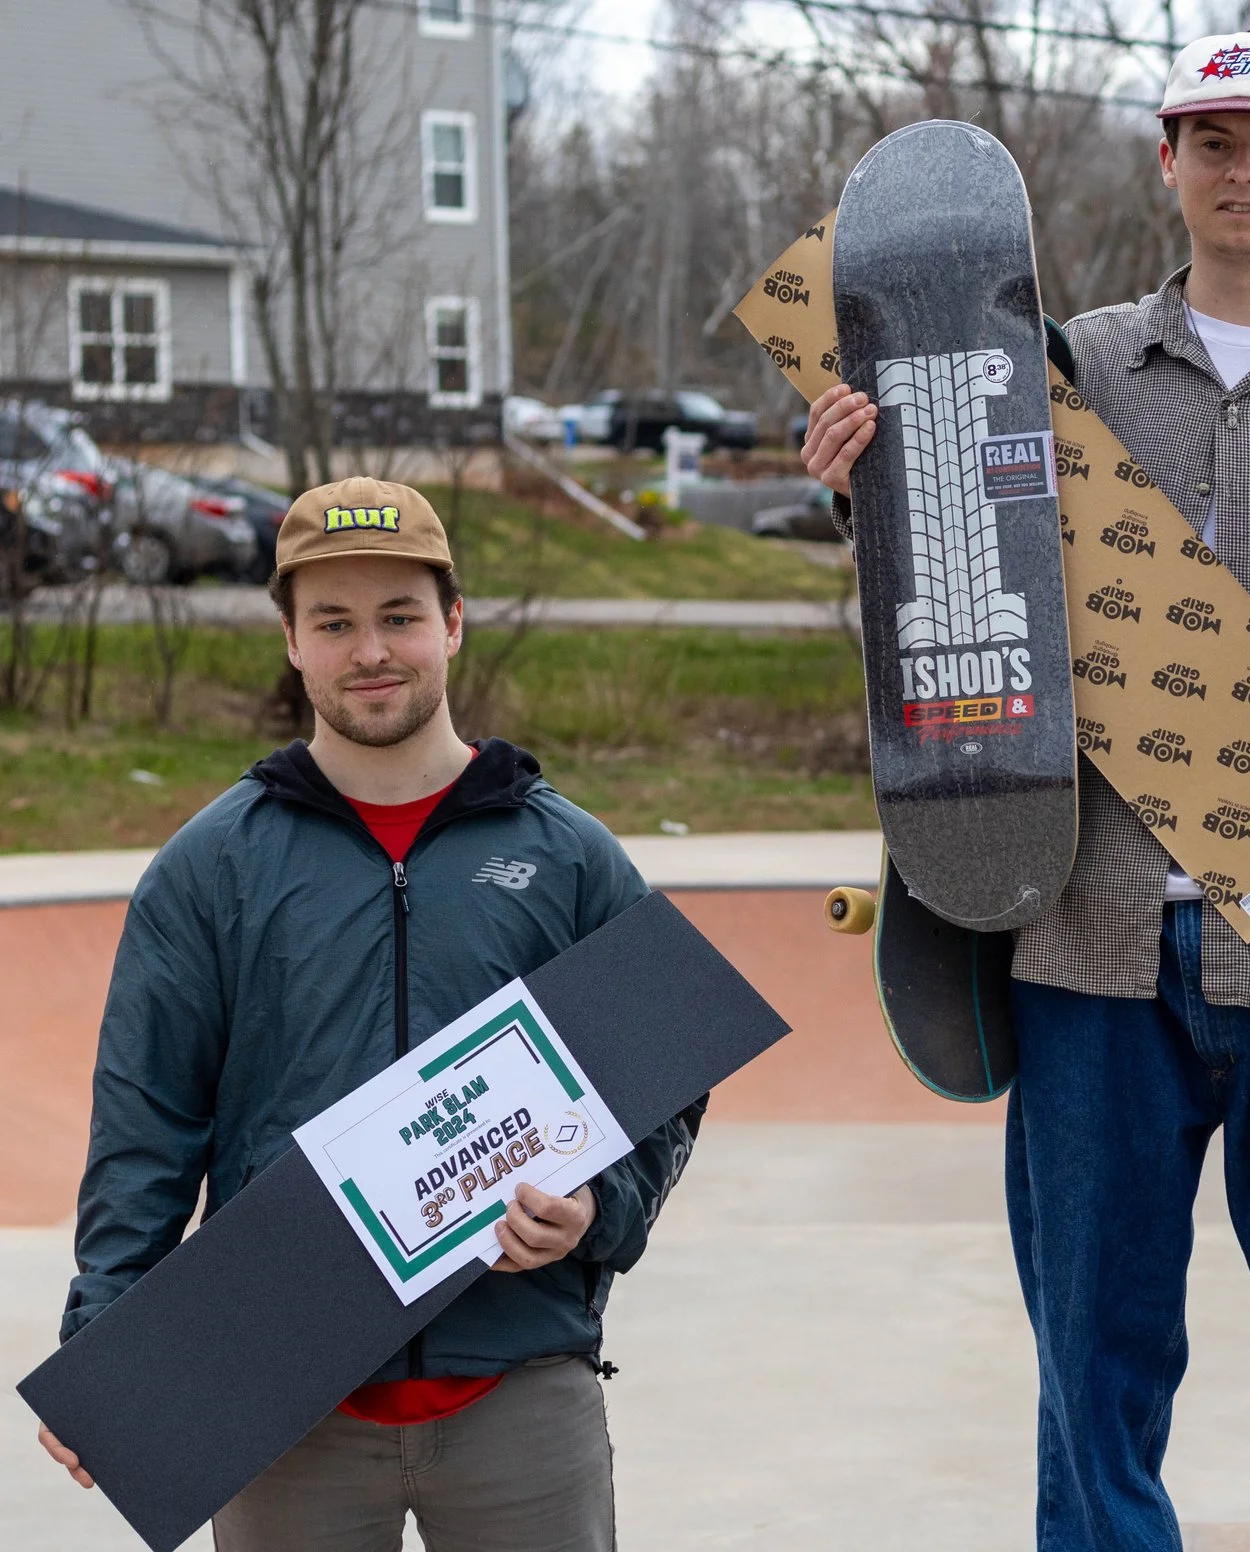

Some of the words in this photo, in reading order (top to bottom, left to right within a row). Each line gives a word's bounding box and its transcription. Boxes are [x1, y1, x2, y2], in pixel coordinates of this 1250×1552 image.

[763, 277, 810, 307] MOB
[985, 442, 1040, 466] REAL
[324, 506, 400, 534] huf
[1100, 527, 1156, 558] MOB
[1086, 592, 1141, 623] MOB
[1166, 604, 1221, 635] MOB
[900, 647, 1032, 700] ISHOD'S
[1072, 658, 1126, 690] MOB
[1151, 670, 1206, 701] MOB
[909, 702, 998, 721] SPEED
[1012, 698, 1028, 714] &
[1136, 735, 1192, 766] MOB
[399, 1106, 445, 1146] PARK
[444, 1075, 490, 1115] SLAM
[424, 1088, 449, 1110] WISE
[432, 1108, 477, 1147] 2024
[413, 1107, 532, 1201] ADVANCED
[420, 1186, 456, 1228] 3RD
[457, 1127, 546, 1202] PLACE
